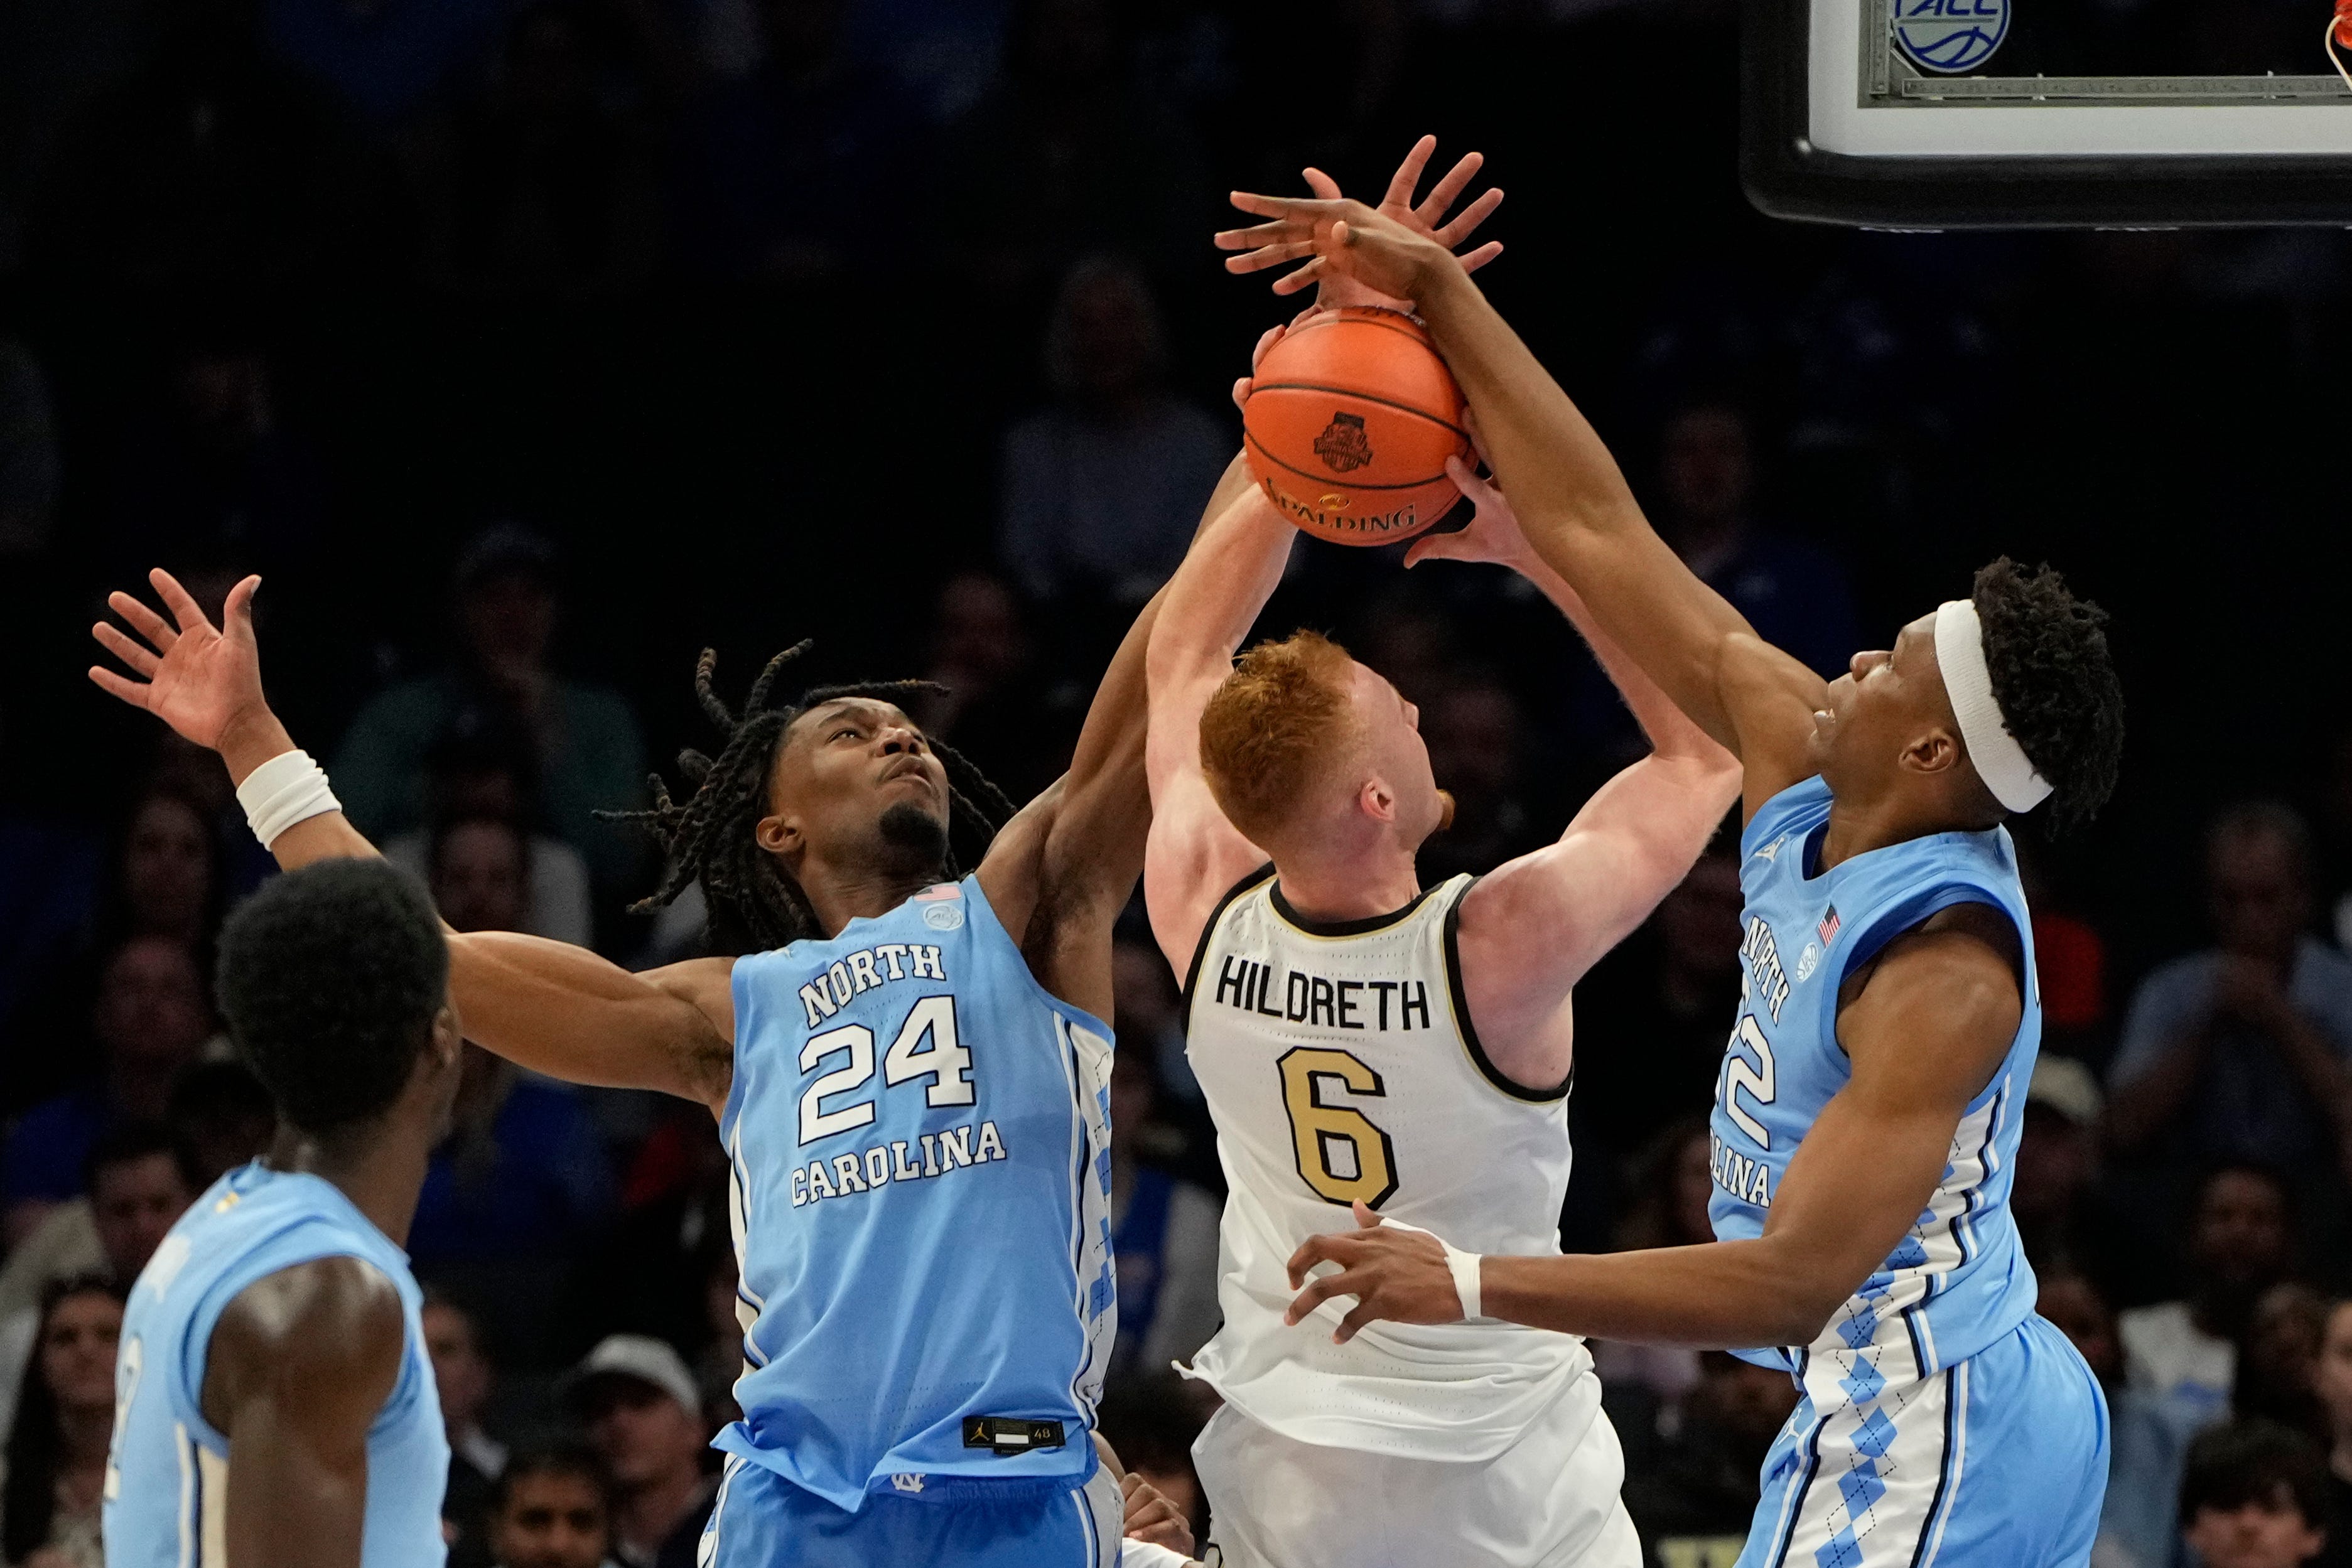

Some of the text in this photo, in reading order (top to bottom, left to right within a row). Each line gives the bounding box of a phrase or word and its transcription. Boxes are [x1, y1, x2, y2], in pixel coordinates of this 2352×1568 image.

[799, 943, 947, 1029] NORTH
[1216, 955, 1430, 1031] HILDRETH
[798, 994, 976, 1147] 24
[790, 1121, 1007, 1208] CAROLINA
[1276, 1046, 1400, 1210] 6
